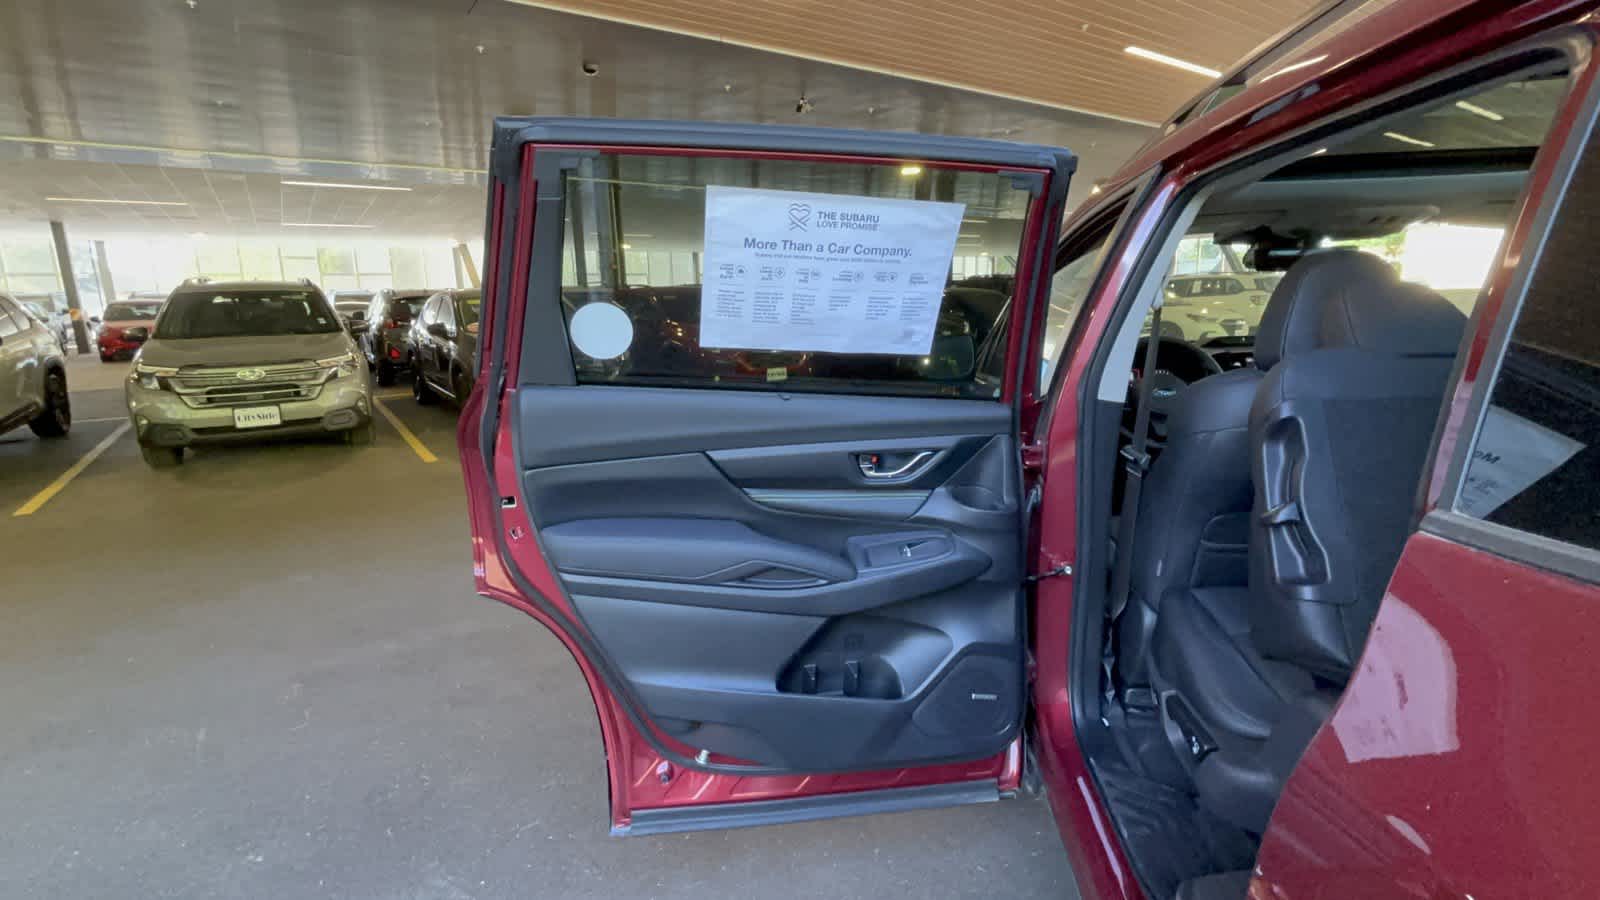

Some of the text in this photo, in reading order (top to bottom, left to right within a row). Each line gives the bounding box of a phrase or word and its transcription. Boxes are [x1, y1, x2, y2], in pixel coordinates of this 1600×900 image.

[817, 211, 880, 224] THE SUBARU
[816, 220, 879, 231] LOVE PROMISE
[743, 237, 913, 258] More Than a Car Company.
